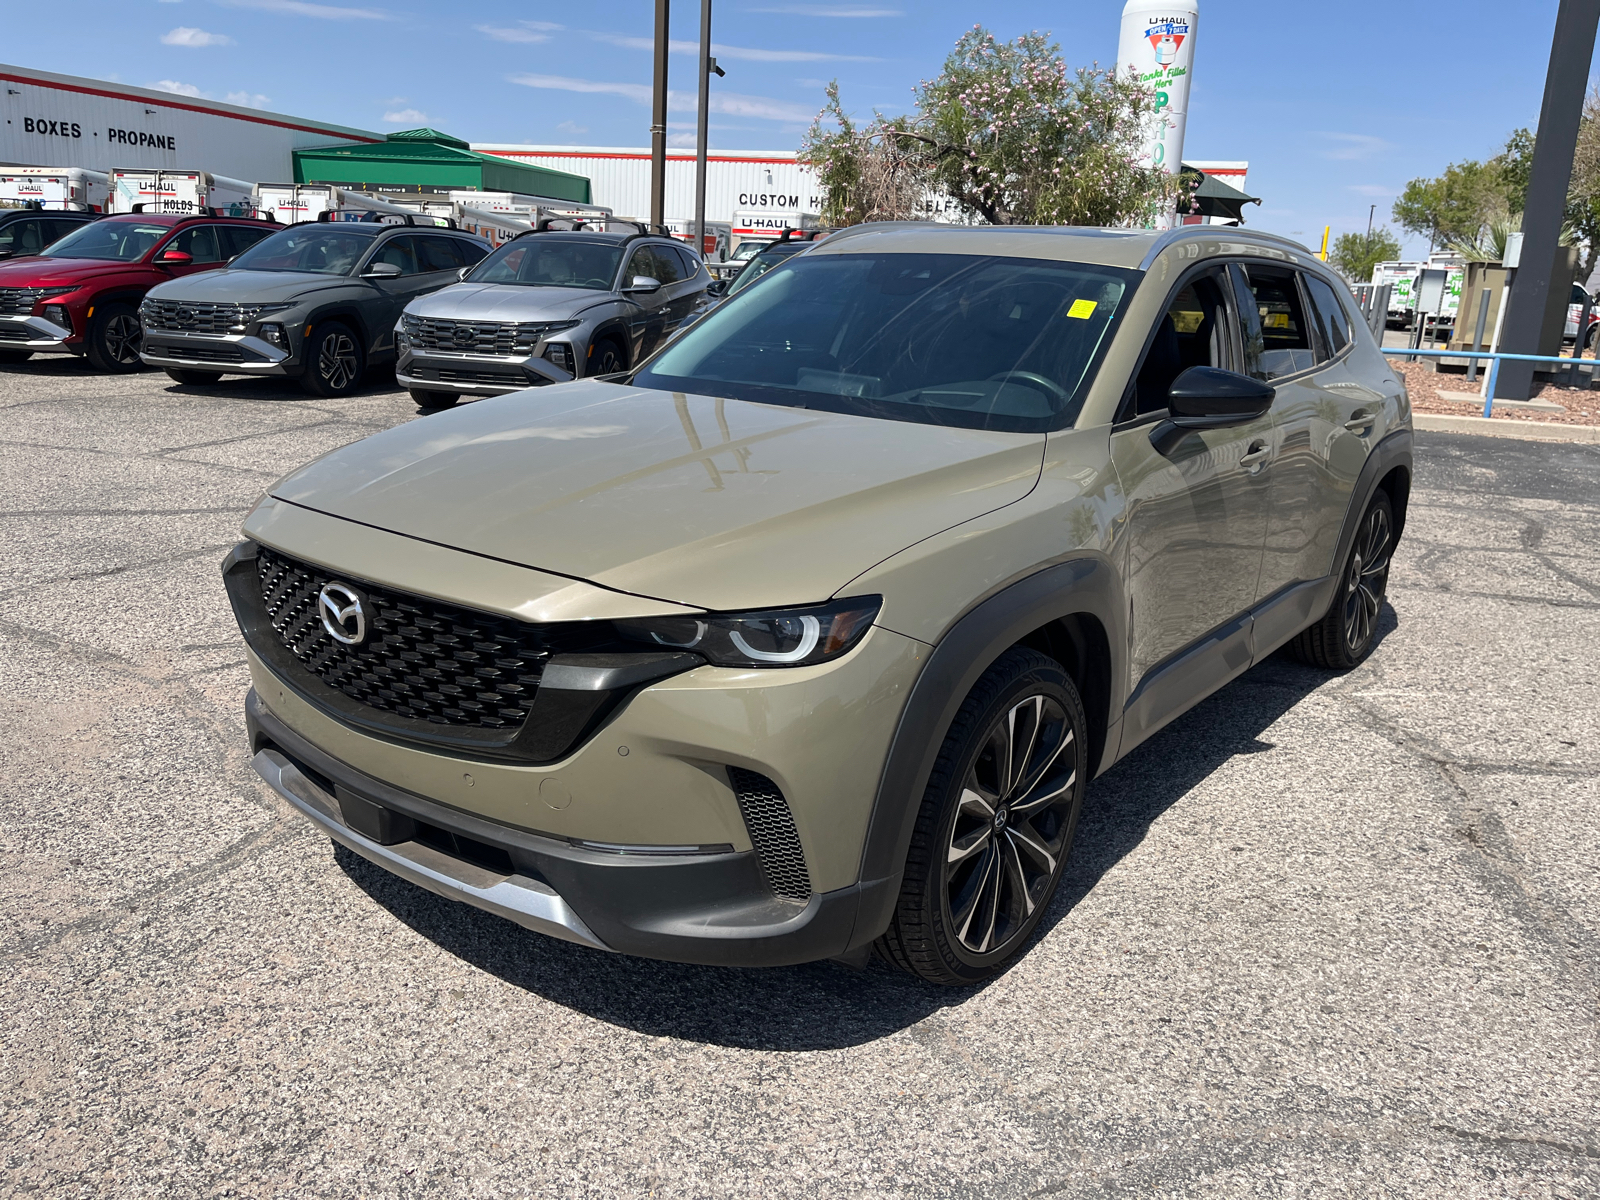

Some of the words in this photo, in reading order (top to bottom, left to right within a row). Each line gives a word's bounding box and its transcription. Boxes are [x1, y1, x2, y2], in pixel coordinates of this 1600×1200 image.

[1149, 17, 1187, 25] U-HAUL
[1149, 25, 1166, 35] OPEN
[1140, 69, 1164, 82] Tanks
[1167, 65, 1187, 78] Filled
[1154, 79, 1173, 88] Here
[24, 117, 82, 138] BOXES
[108, 128, 176, 150] PROPANE
[139, 182, 176, 192] U-HAUL
[163, 199, 193, 210] HOLDS
[739, 194, 799, 208] CUSTOM
[742, 218, 791, 228] U-HAUL
[932, 910, 963, 972] IRONMAN
